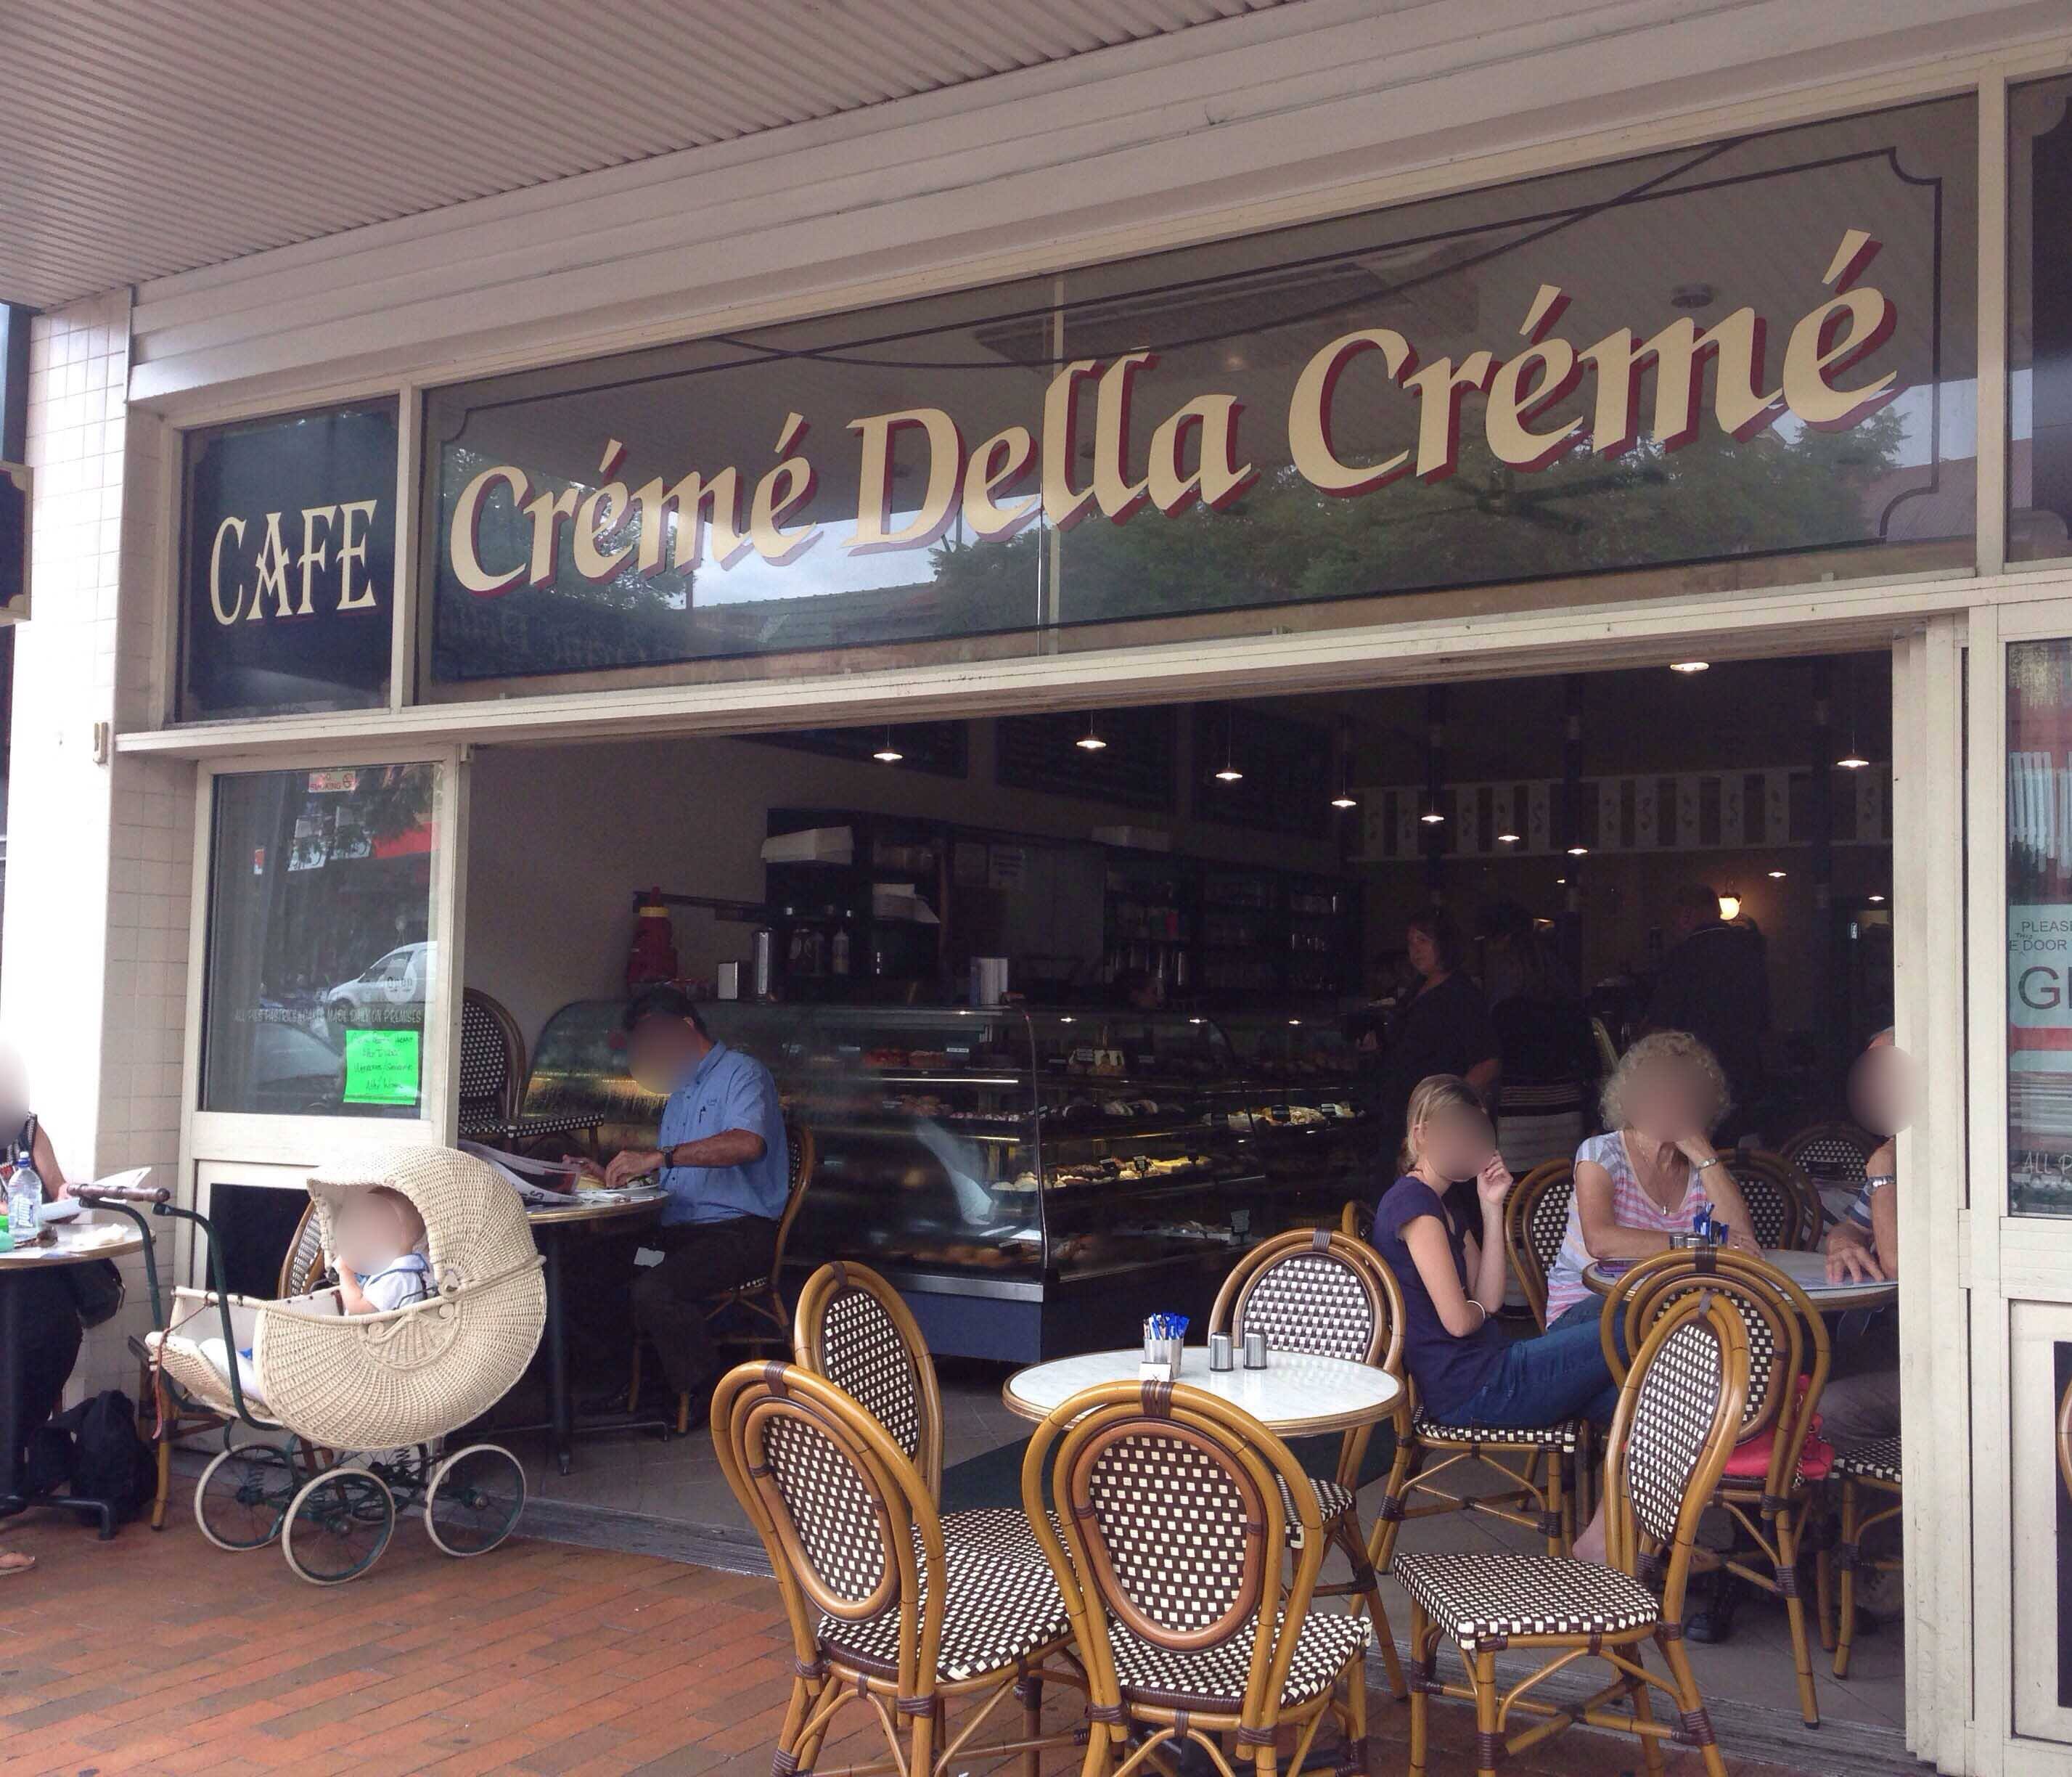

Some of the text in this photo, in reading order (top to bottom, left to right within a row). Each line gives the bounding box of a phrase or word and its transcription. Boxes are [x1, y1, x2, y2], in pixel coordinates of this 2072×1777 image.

[450, 229, 1904, 595] Crémé Della Crémé
[210, 499, 378, 626] CAFE
[2021, 920, 2072, 933] PLEAS
[2023, 939, 2068, 952] DOOR
[2018, 965, 2072, 1010] G
[384, 1010, 422, 1022] PREMISES
[2022, 1149, 2052, 1175] ALL
